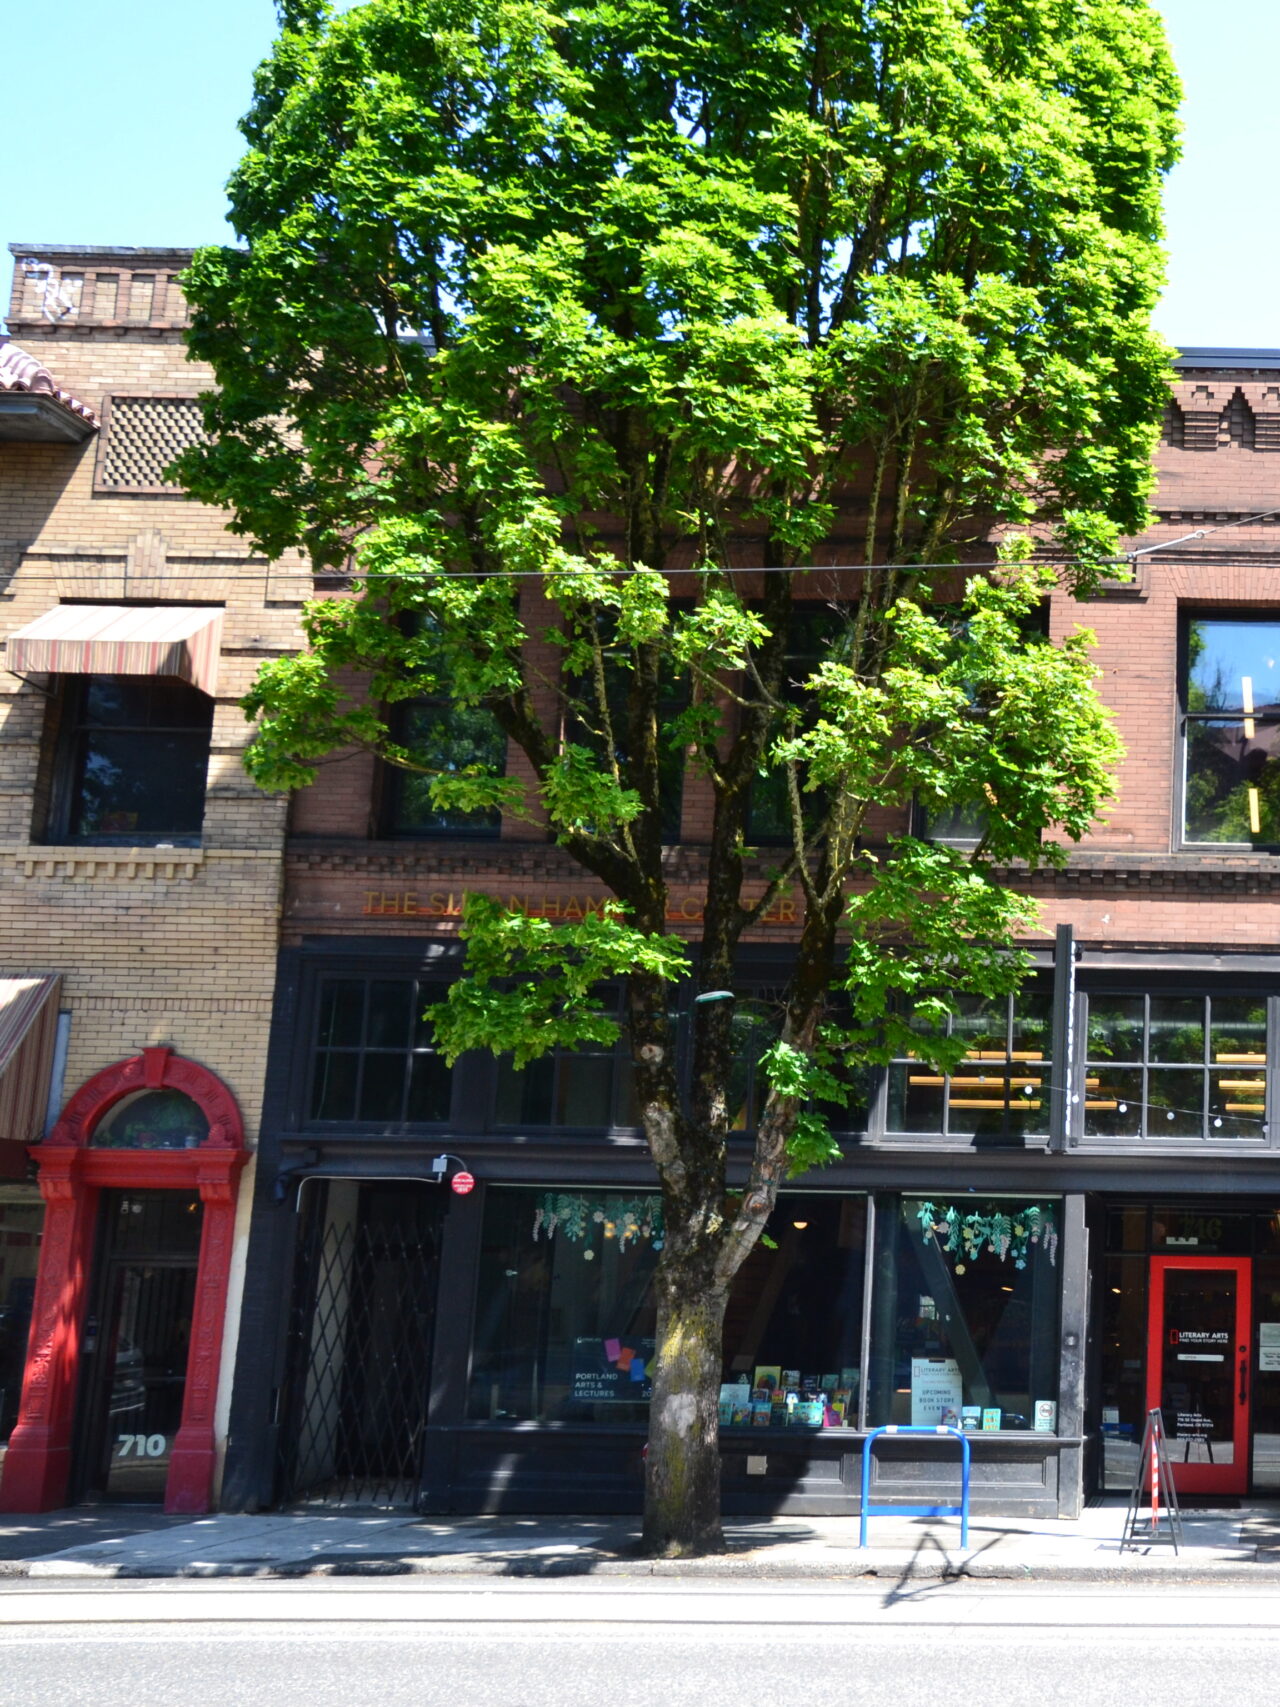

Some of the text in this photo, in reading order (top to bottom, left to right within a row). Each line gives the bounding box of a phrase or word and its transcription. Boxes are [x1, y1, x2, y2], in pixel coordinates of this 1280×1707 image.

[363, 891, 417, 915] THE
[1179, 1331, 1229, 1340] LITERARY ARTS
[575, 1372, 619, 1380] PORTLAND
[574, 1381, 603, 1389] ARTS &
[574, 1390, 615, 1398] LECTURES
[118, 1433, 167, 1457] 710
